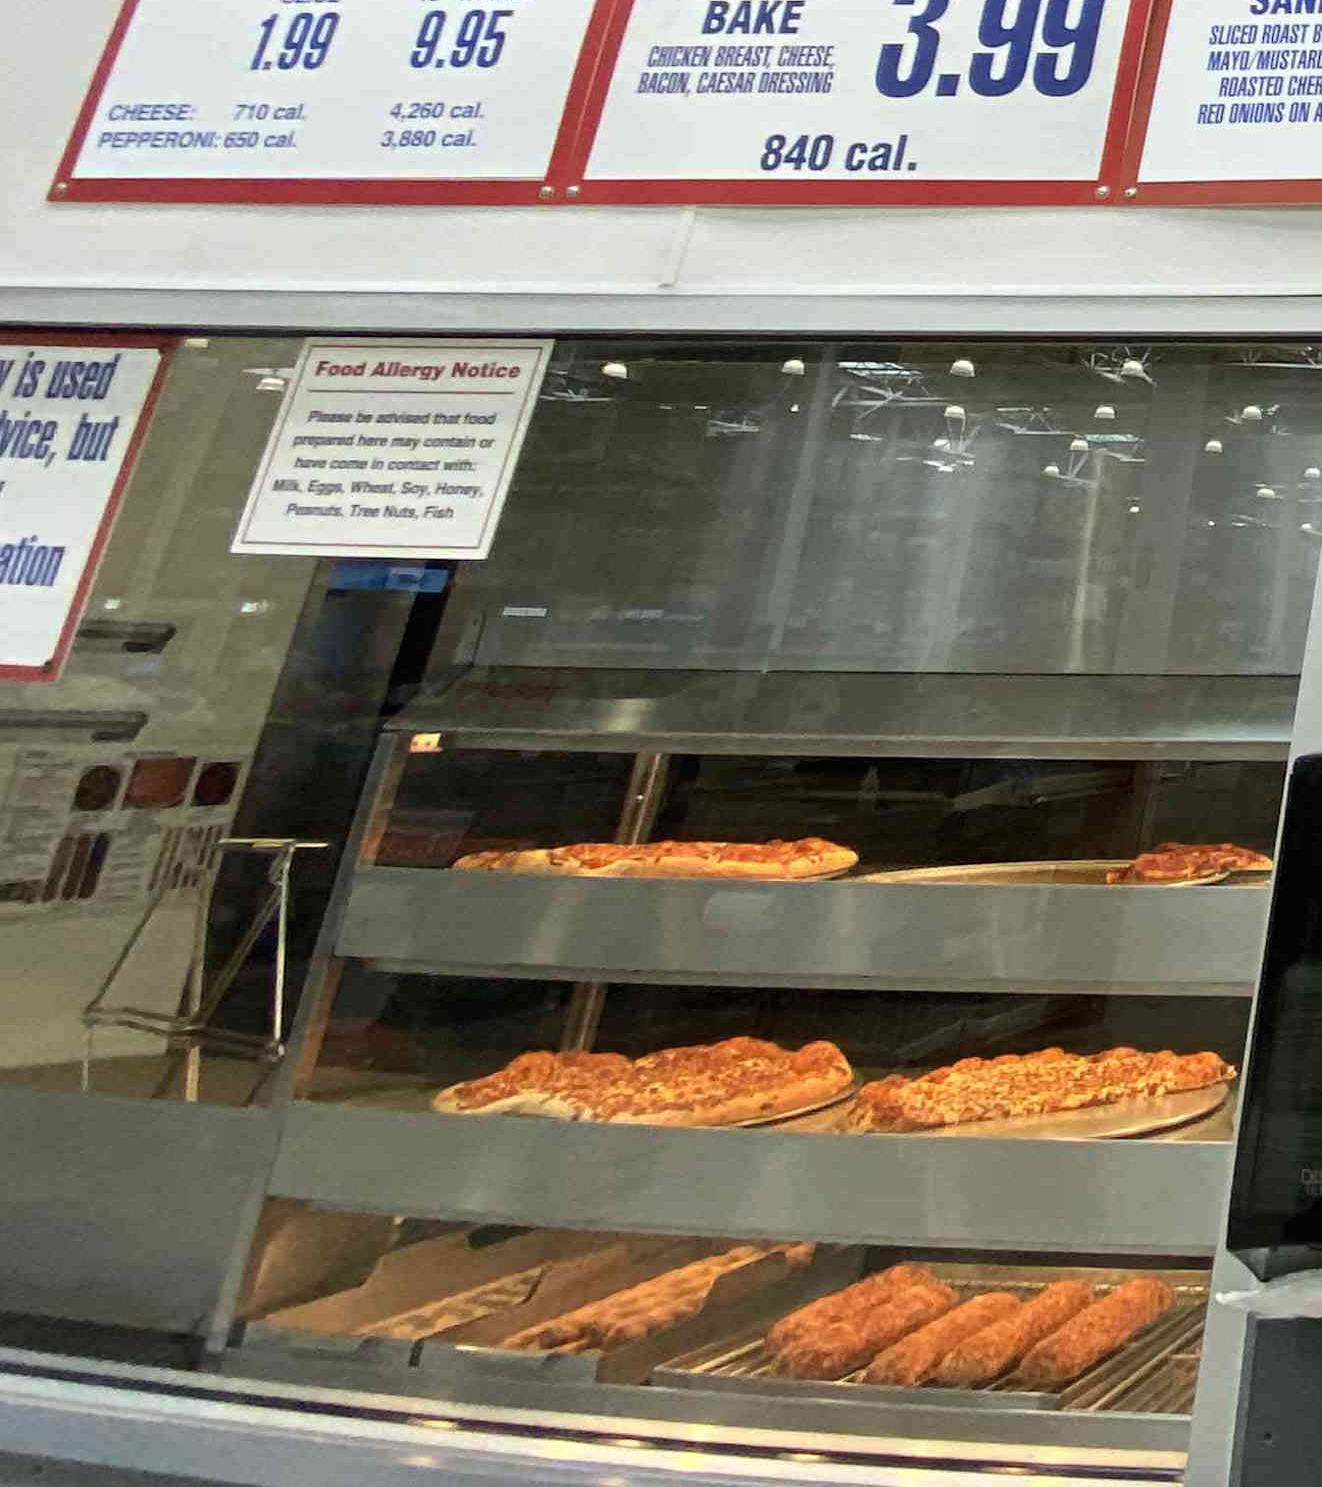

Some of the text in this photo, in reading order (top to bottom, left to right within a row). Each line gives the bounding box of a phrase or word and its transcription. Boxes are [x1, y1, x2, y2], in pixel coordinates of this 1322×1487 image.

[701, 0, 806, 35] BAKE
[249, 12, 339, 70] 1.99
[409, 10, 514, 68] 9.95
[1208, 24, 1258, 45] SLICED
[1261, 24, 1310, 45] ROAST
[648, 45, 835, 69] CHICKEN BREAST, CHEESE,
[637, 71, 835, 96] BACON, CAESAR DRESSING
[1218, 76, 1283, 98] ROASTED
[108, 104, 306, 121] CHEESE: 710 cal.
[389, 102, 484, 120] 4,260 cal.
[1197, 103, 1225, 125] RED
[1228, 102, 1285, 123] ONIONS
[1288, 102, 1309, 123] ON
[98, 131, 297, 148] PEPPERONI: 650 cal.
[380, 130, 477, 148] 3,880 cal.
[760, 134, 918, 172] 840 cal.
[13, 351, 46, 398] is
[45, 353, 123, 400] used
[315, 360, 521, 382] Food Allergy Notice
[307, 411, 496, 425] Please be advised that food
[67, 413, 120, 461] but
[293, 435, 495, 450] prepared here may contain or
[294, 457, 327, 469] have
[329, 461, 368, 470] come
[370, 458, 384, 470] in
[387, 459, 440, 470] contact
[349, 505, 380, 517] Tree
[423, 506, 454, 518] Fish
